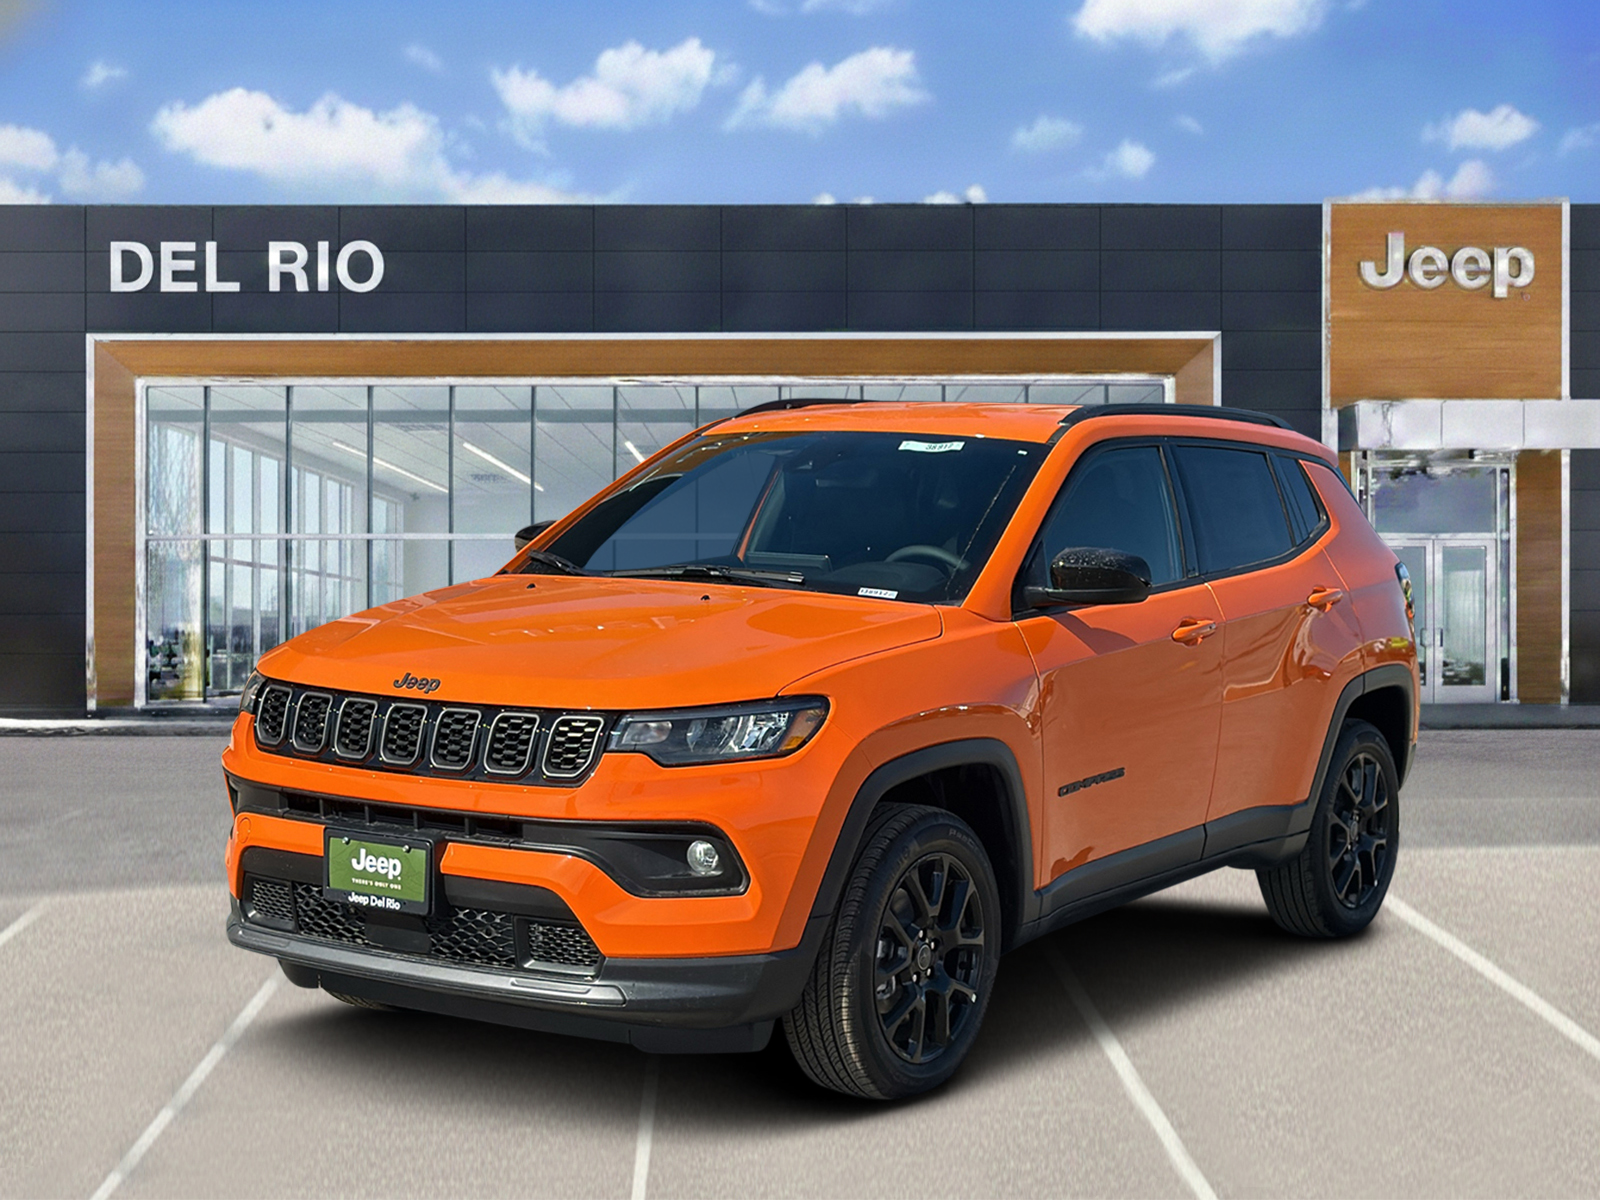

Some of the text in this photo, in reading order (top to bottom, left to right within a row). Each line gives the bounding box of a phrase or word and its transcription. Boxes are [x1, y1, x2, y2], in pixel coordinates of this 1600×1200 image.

[110, 240, 384, 293] DEL RIO
[1360, 232, 1535, 298] Jeep
[393, 672, 441, 694] Jeep
[1058, 767, 1125, 797] COMPASS
[351, 848, 401, 880] Jeep
[348, 891, 401, 910] Jeep Del Rio
